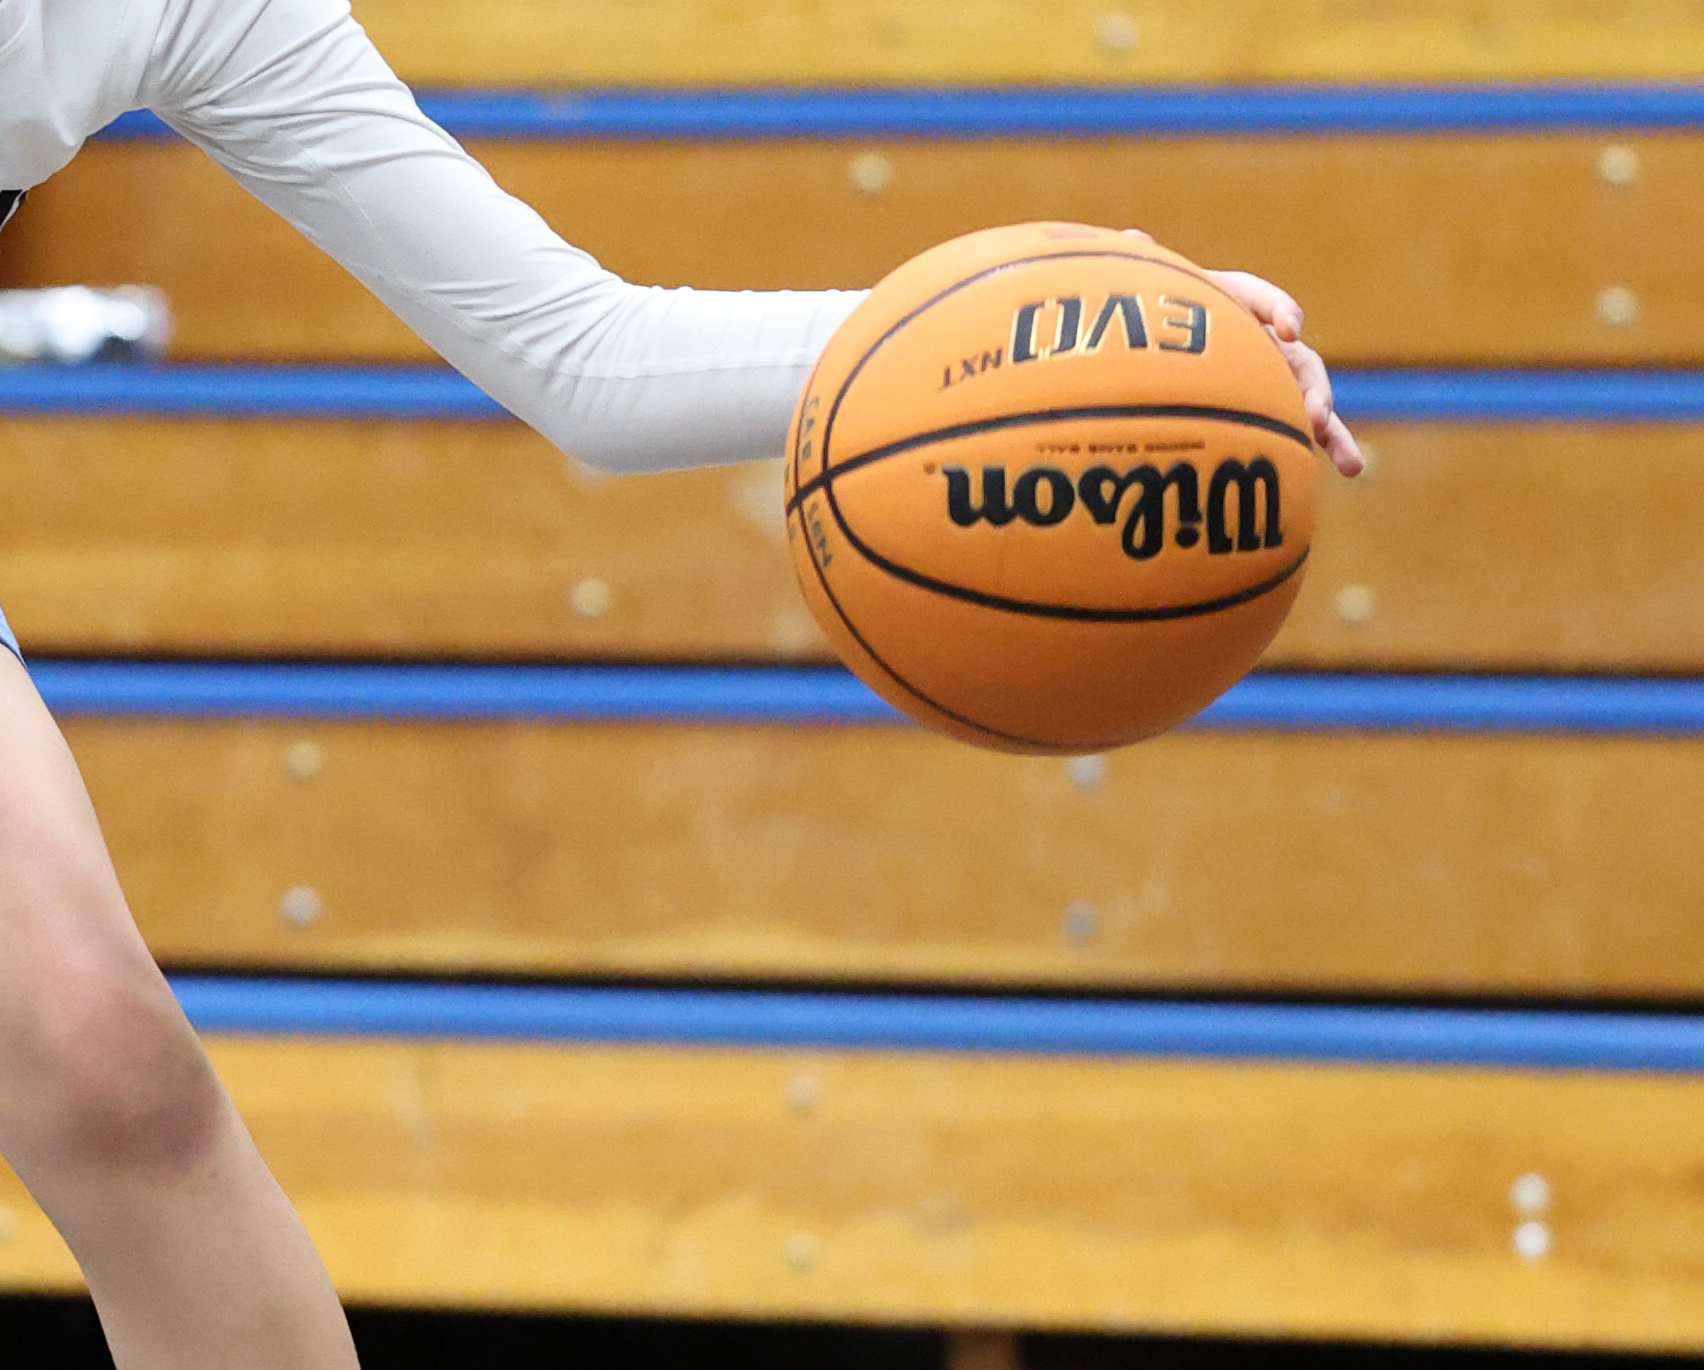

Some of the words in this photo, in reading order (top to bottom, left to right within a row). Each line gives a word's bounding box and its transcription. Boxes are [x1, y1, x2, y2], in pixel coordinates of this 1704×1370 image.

[1008, 292, 1210, 367] EVO
[937, 348, 1002, 391] NXT
[941, 455, 1284, 560] Wilson
